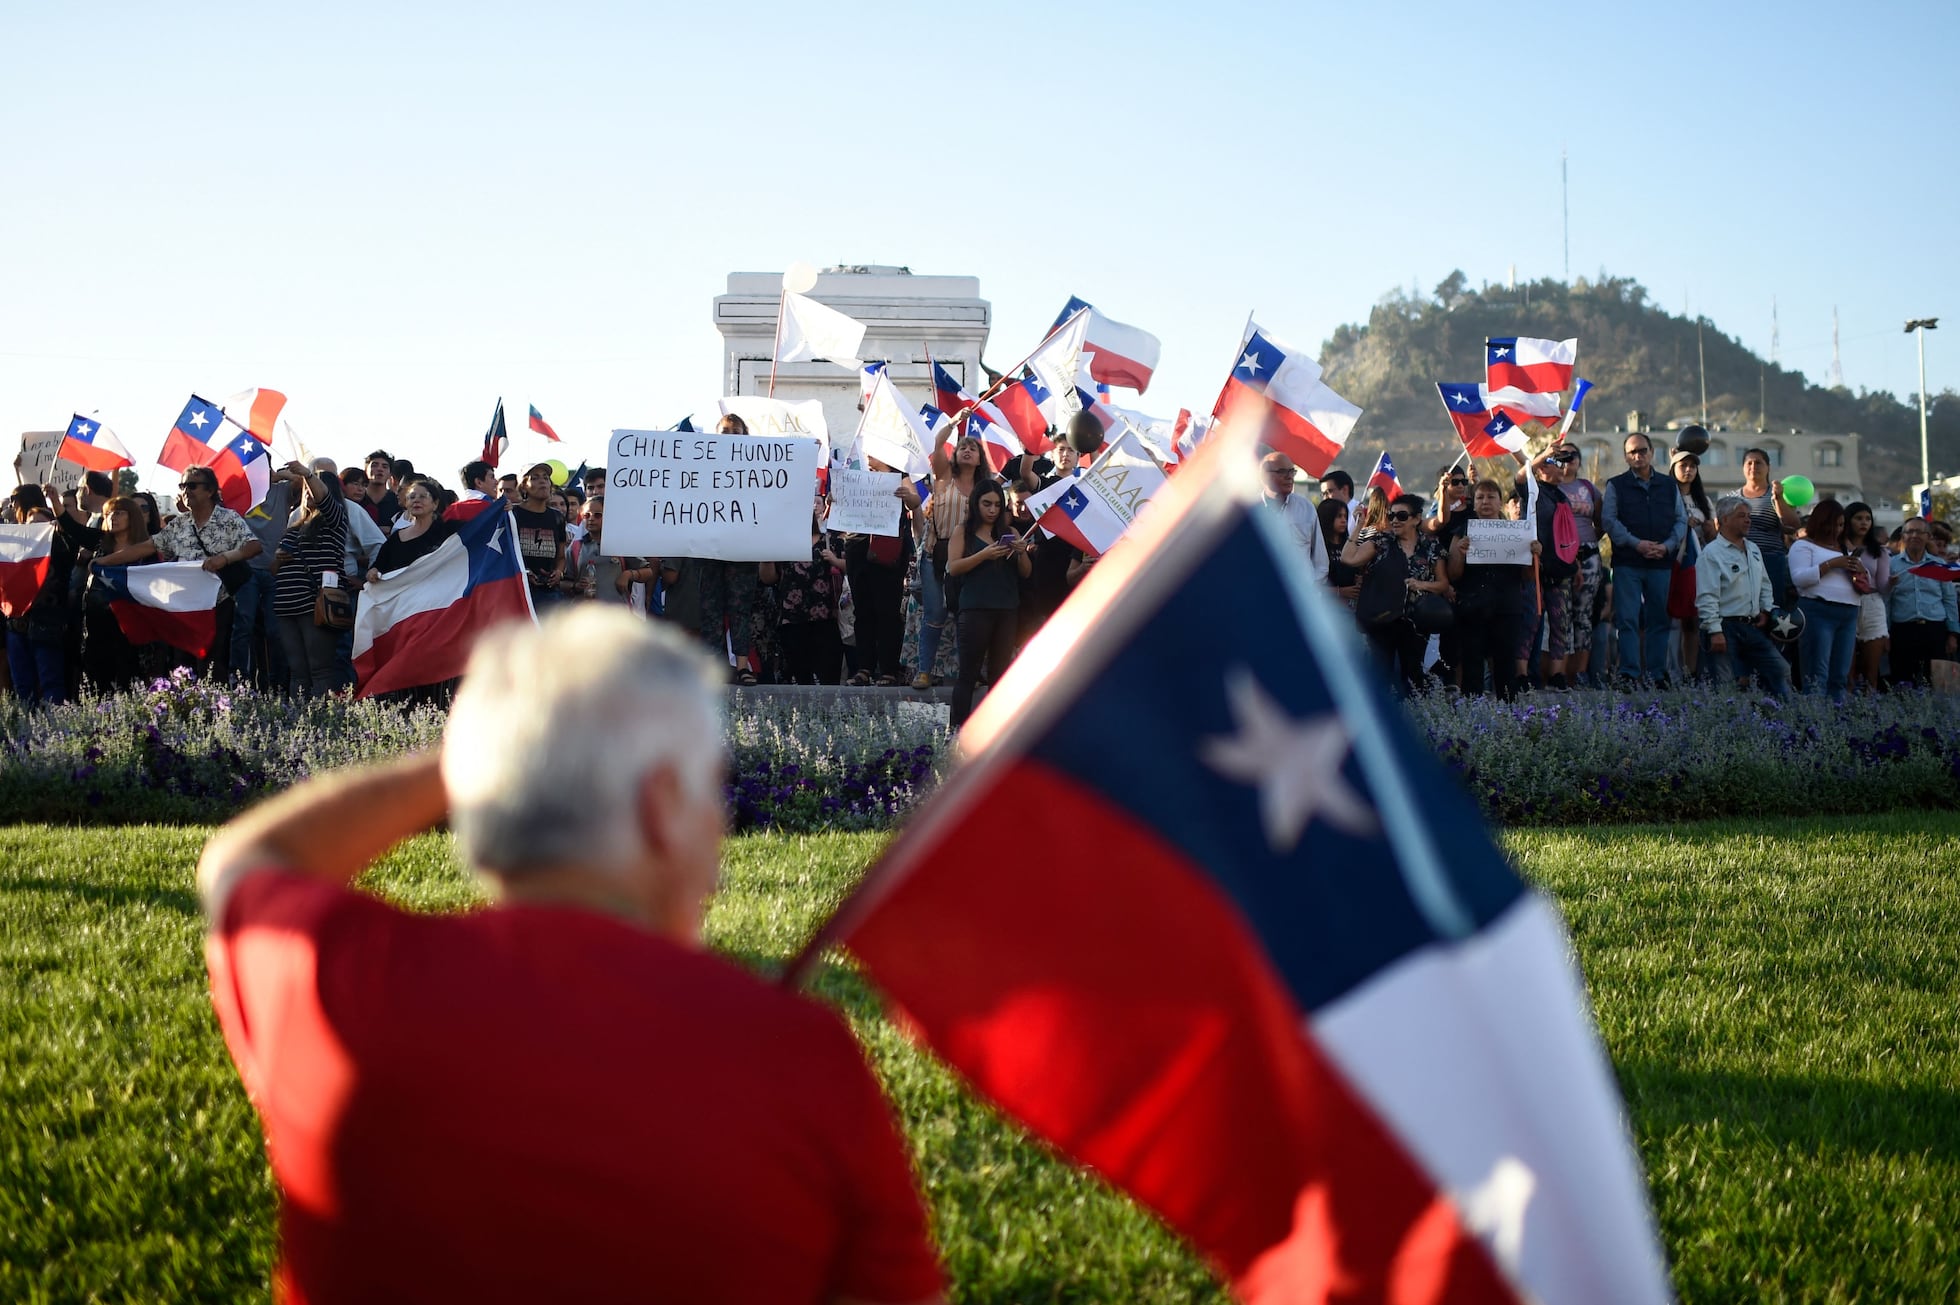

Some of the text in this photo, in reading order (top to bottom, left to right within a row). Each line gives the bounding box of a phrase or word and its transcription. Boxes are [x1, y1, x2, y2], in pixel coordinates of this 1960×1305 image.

[617, 434, 795, 462] CHILE SE HUNDE
[613, 467, 789, 490] GOLPE DE ESTADO
[1108, 495, 1133, 522] CARABINERO
[1467, 549, 1497, 559] BASTA
